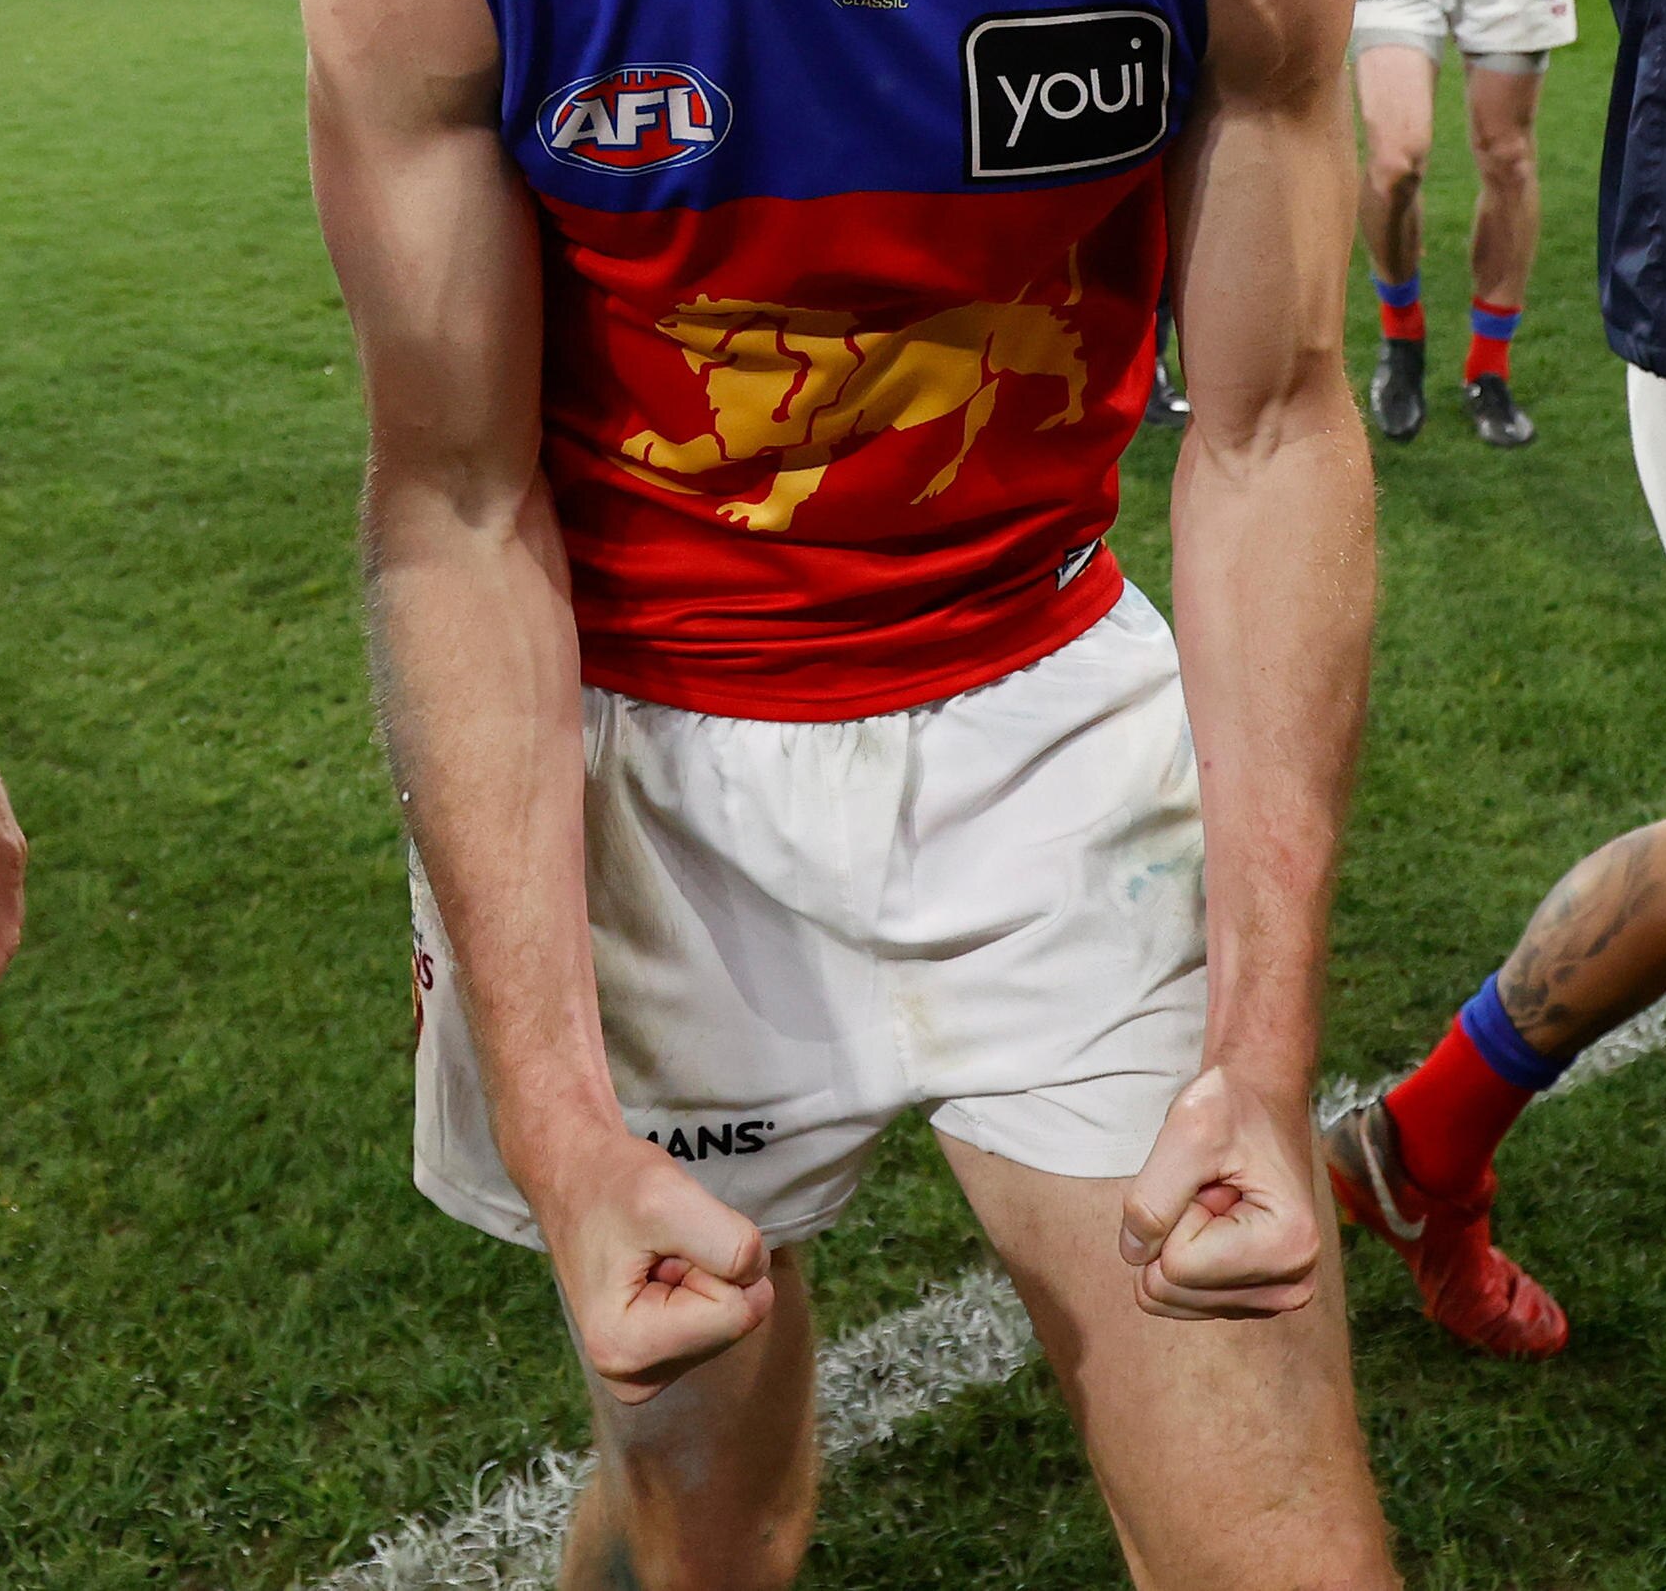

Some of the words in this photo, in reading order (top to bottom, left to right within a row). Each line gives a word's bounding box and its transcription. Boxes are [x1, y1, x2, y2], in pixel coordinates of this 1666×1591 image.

[550, 87, 715, 149] AFL
[997, 37, 1144, 148] youi
[646, 1120, 767, 1162] ANS
